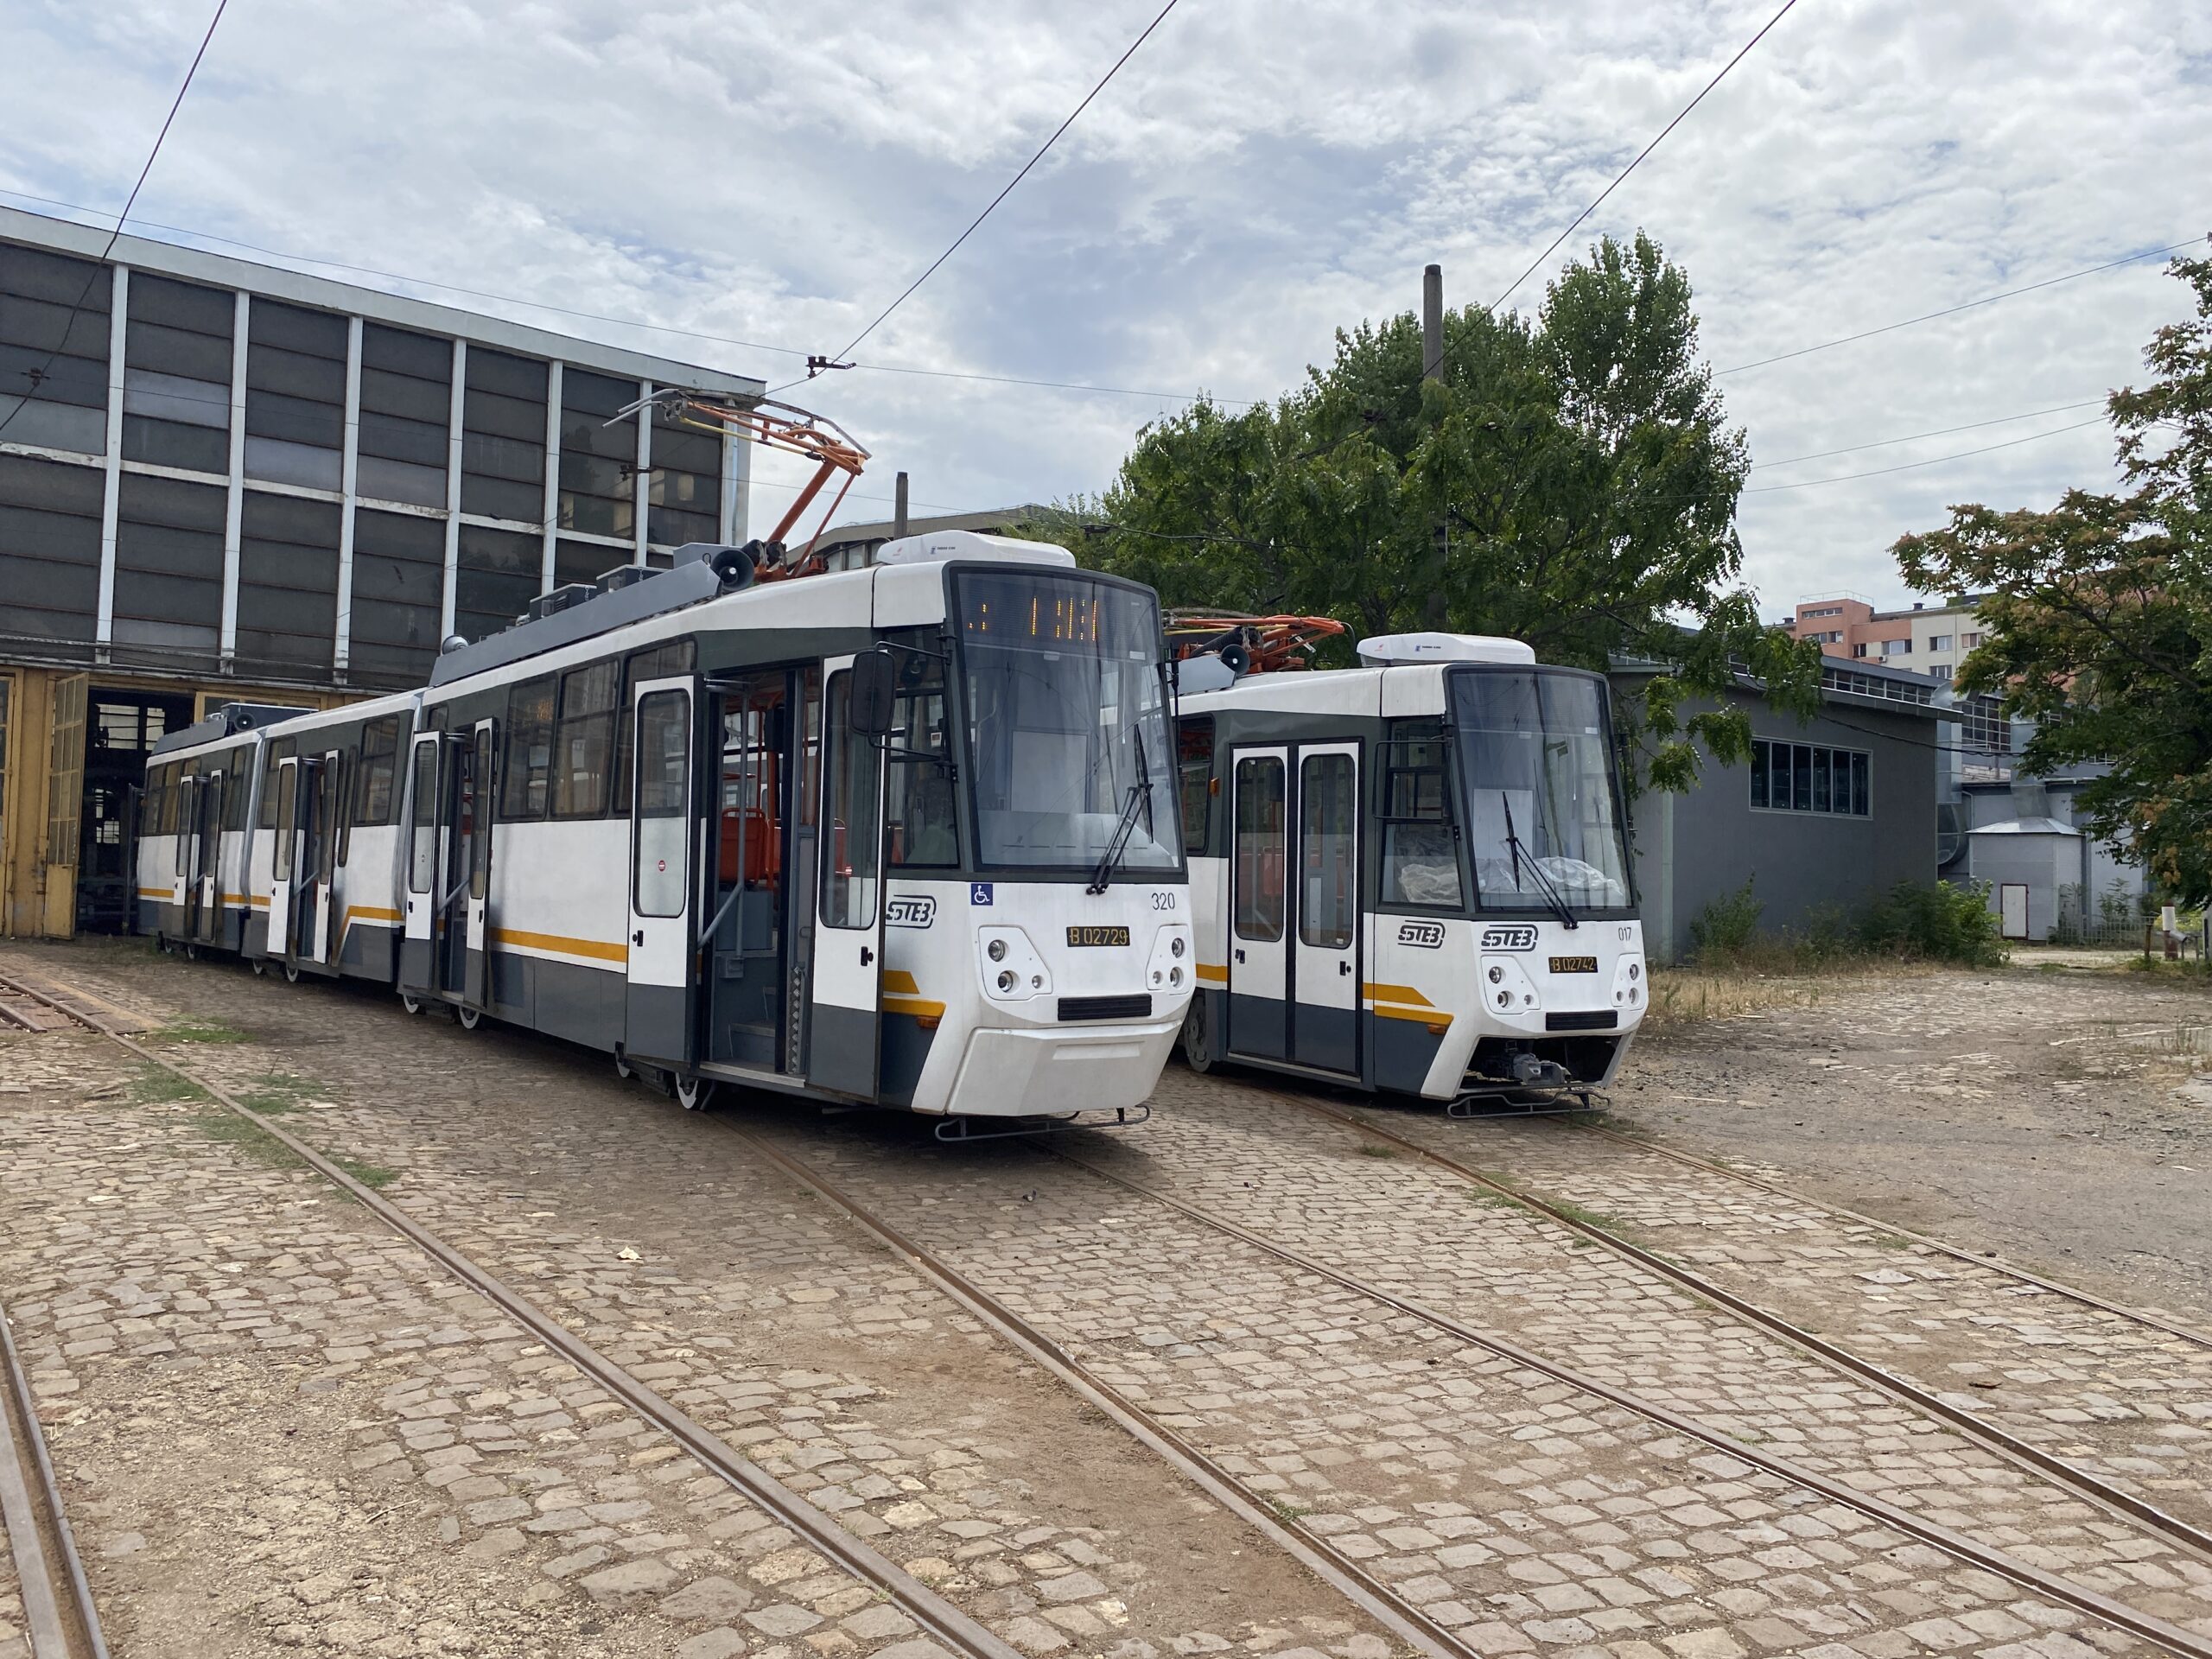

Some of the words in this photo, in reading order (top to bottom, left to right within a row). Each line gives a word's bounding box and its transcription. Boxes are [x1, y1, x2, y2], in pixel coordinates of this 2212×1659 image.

[1151, 892, 1175, 910] 320
[886, 900, 931, 923] STB
[1071, 927, 1080, 944] B
[1084, 928, 1127, 945] 02729
[1398, 924, 1441, 944] STB
[1480, 929, 1534, 948] STB
[1618, 926, 1632, 941] 017
[1552, 958, 1560, 971] B
[1562, 957, 1594, 971] 02742
